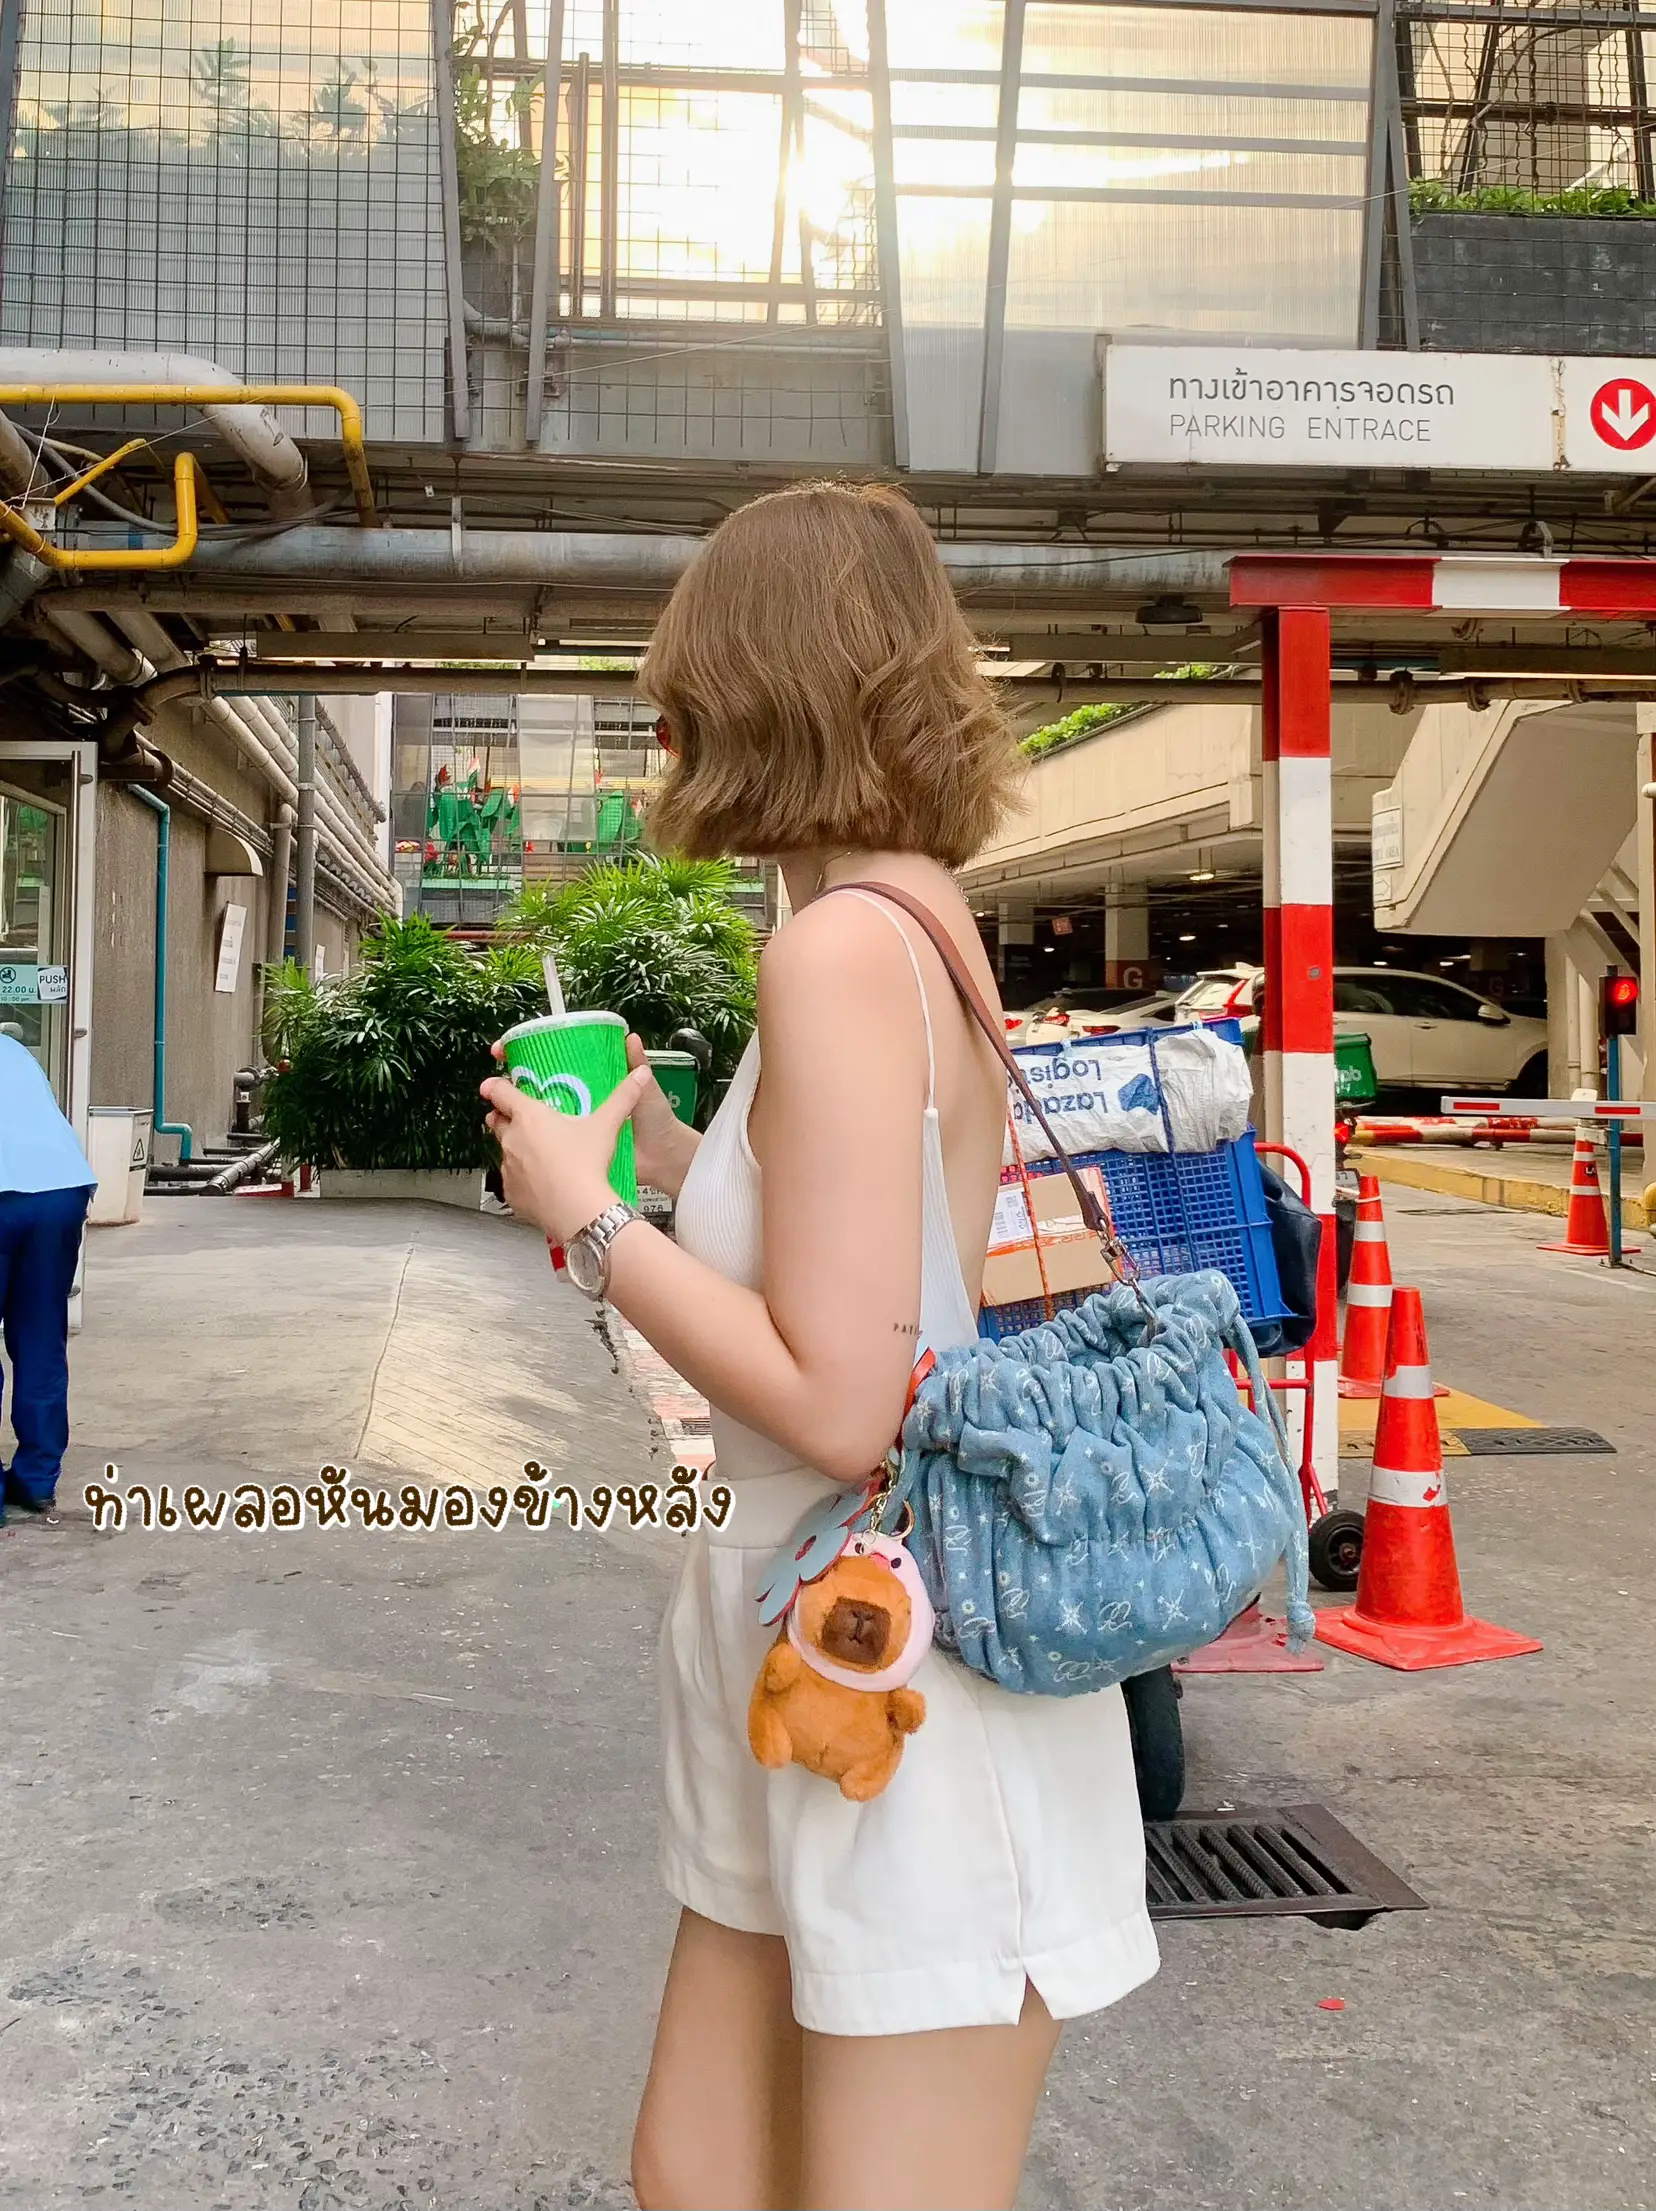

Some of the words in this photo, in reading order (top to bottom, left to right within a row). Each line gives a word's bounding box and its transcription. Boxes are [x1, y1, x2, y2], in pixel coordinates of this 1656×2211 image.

[1169, 367, 1454, 405] ทางเข้าอาคารจอดรถ
[1170, 413, 1285, 439] PARKING
[1308, 417, 1431, 441] ENTRACE
[40, 975, 66, 984] PUSH
[1123, 966, 1143, 990] G
